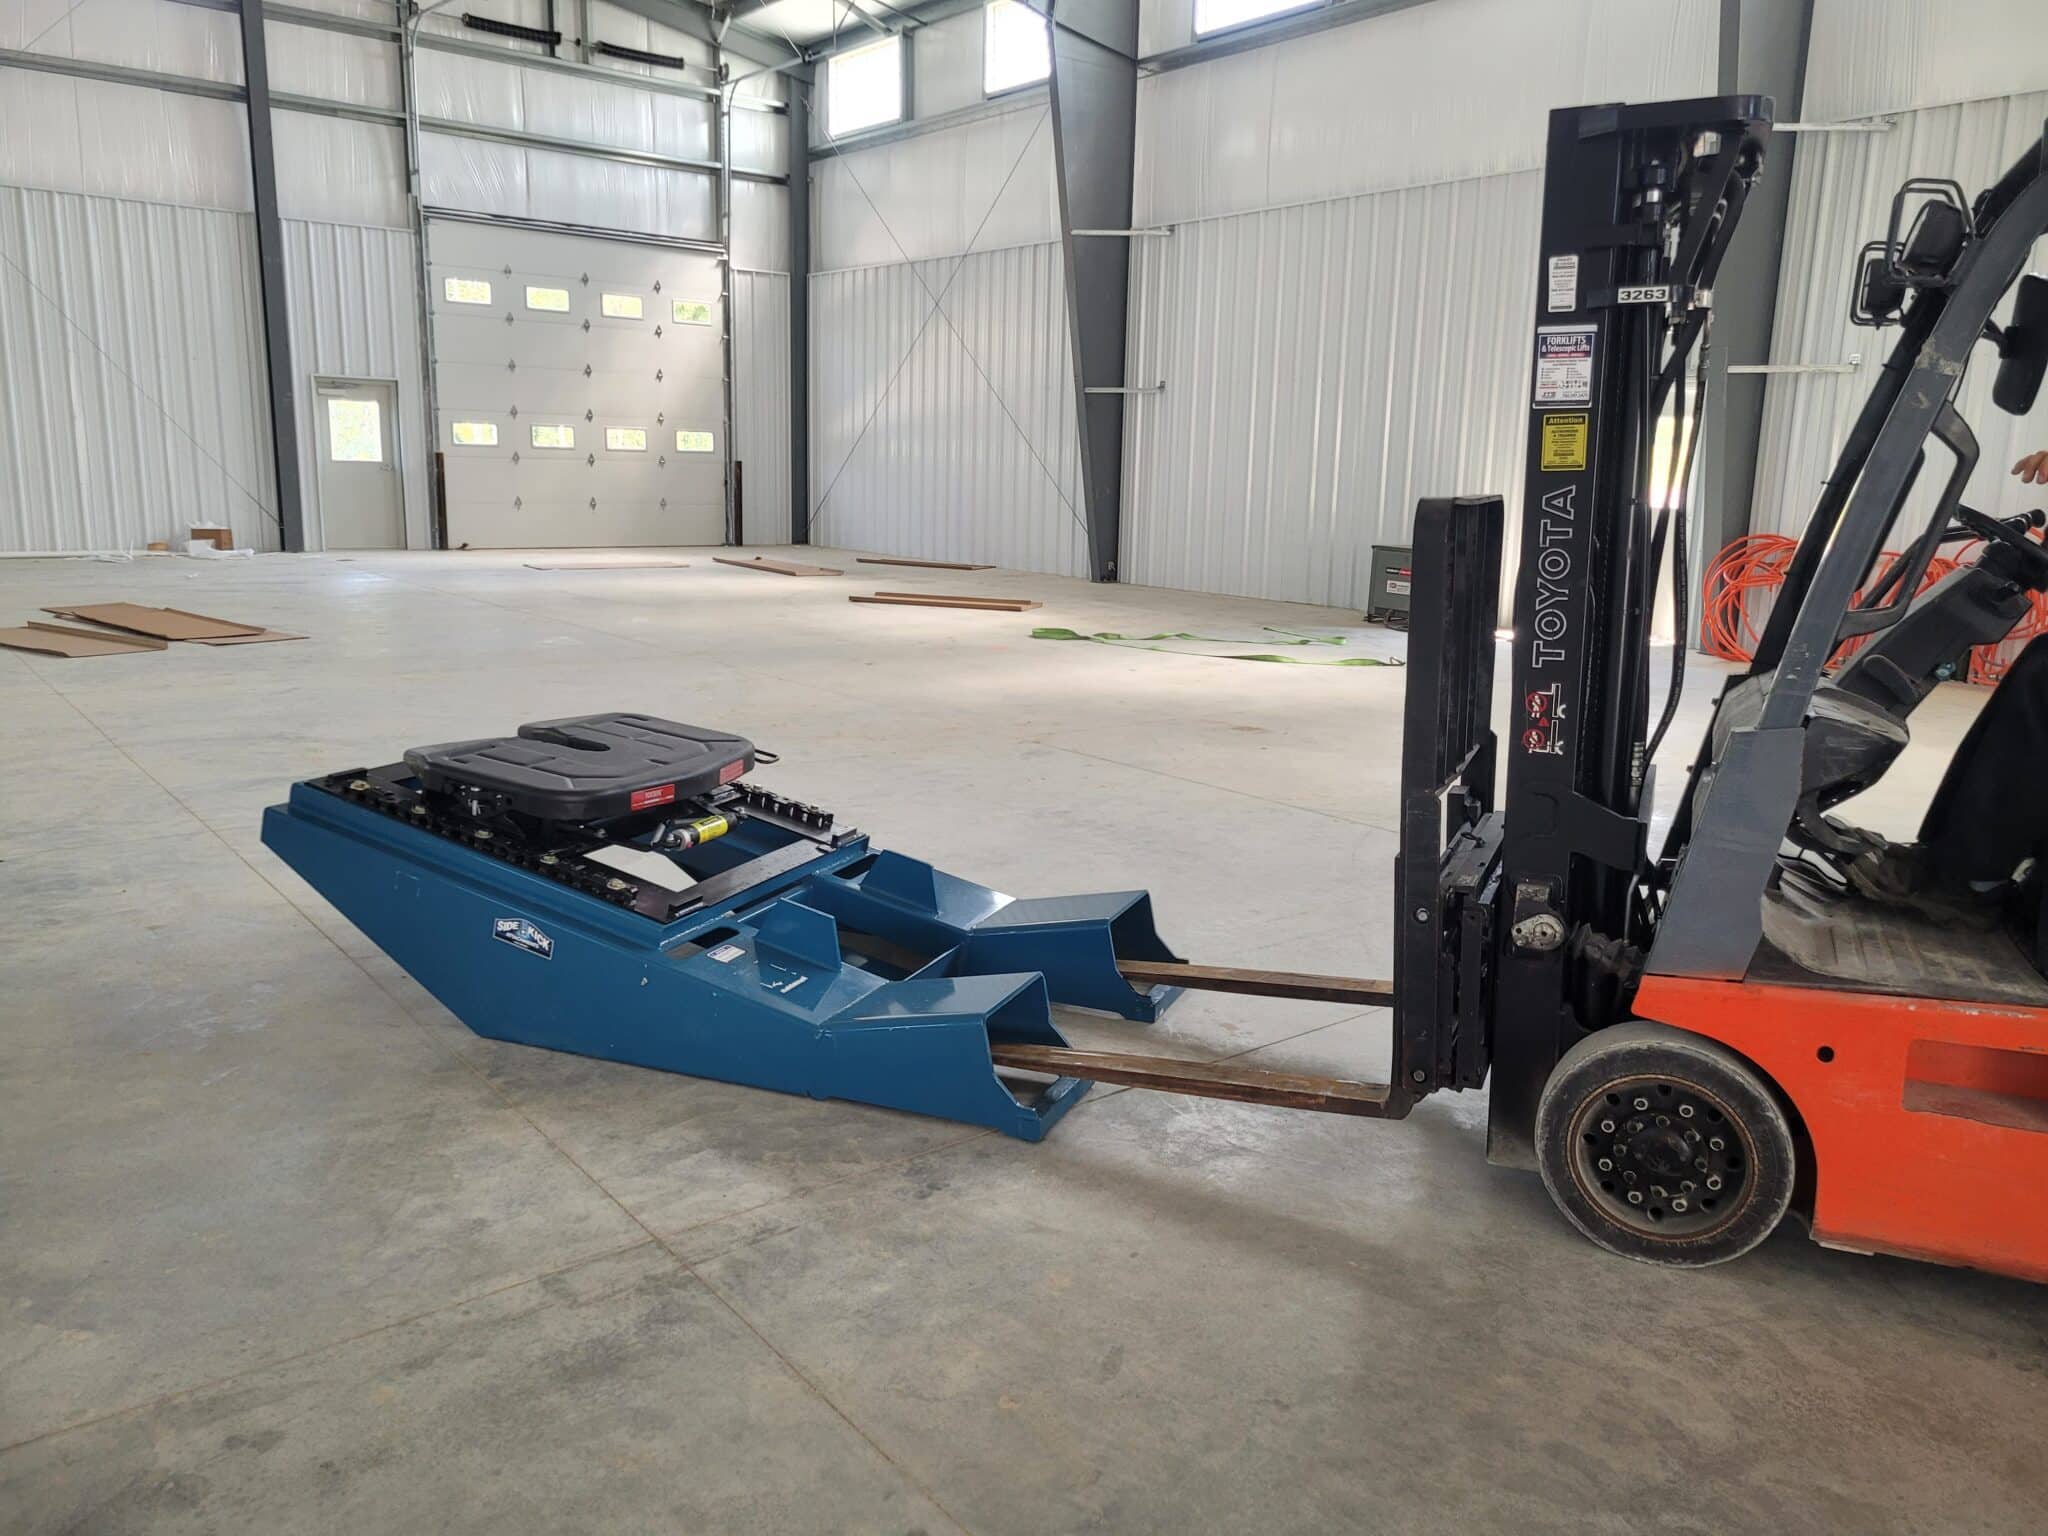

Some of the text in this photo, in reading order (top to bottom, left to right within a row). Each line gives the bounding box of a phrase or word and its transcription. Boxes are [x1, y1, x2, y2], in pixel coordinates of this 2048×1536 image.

[1620, 289, 1667, 301] 3263
[1547, 335, 1586, 345] FORKLIFTS
[1548, 416, 1583, 425] Attention
[1532, 484, 1576, 668] TOYOTA
[497, 920, 521, 932] SIDE
[527, 925, 551, 951] KICK
